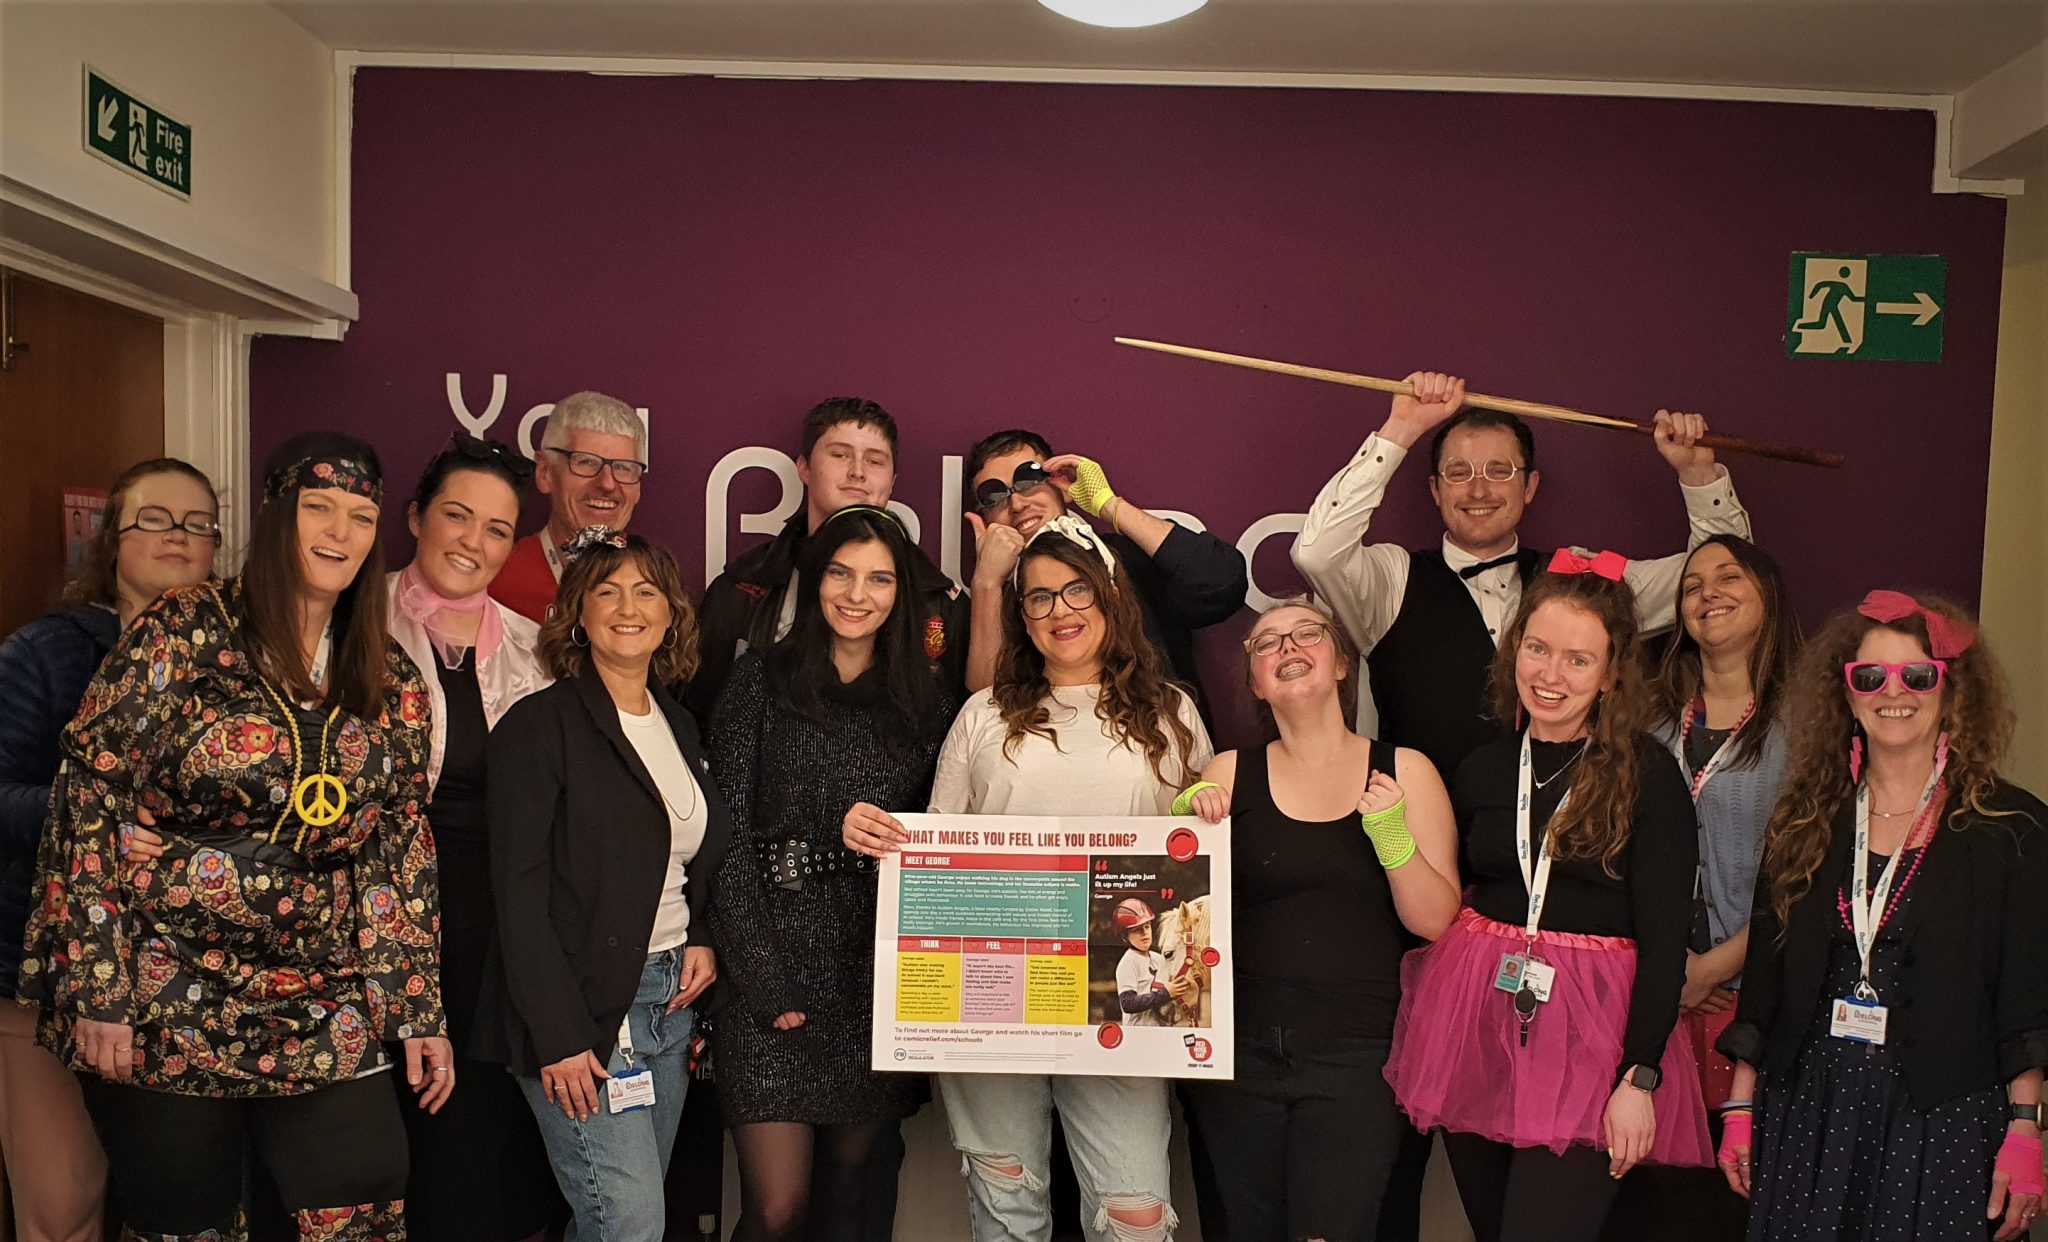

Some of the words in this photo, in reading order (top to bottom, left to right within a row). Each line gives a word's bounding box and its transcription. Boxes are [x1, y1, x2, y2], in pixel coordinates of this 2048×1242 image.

[156, 118, 183, 154] Fire
[155, 156, 183, 186] exit
[938, 831, 979, 845] MAKES
[983, 832, 1005, 846] YOU
[1009, 832, 1034, 846] FEEL
[1038, 833, 1060, 847] LIKE
[1064, 833, 1085, 847] YOU
[1089, 833, 1137, 847] BELONG?
[905, 856, 923, 865] MEET
[925, 856, 951, 866] GEORGE
[1119, 873, 1142, 881] Angels
[1143, 873, 1156, 881] just
